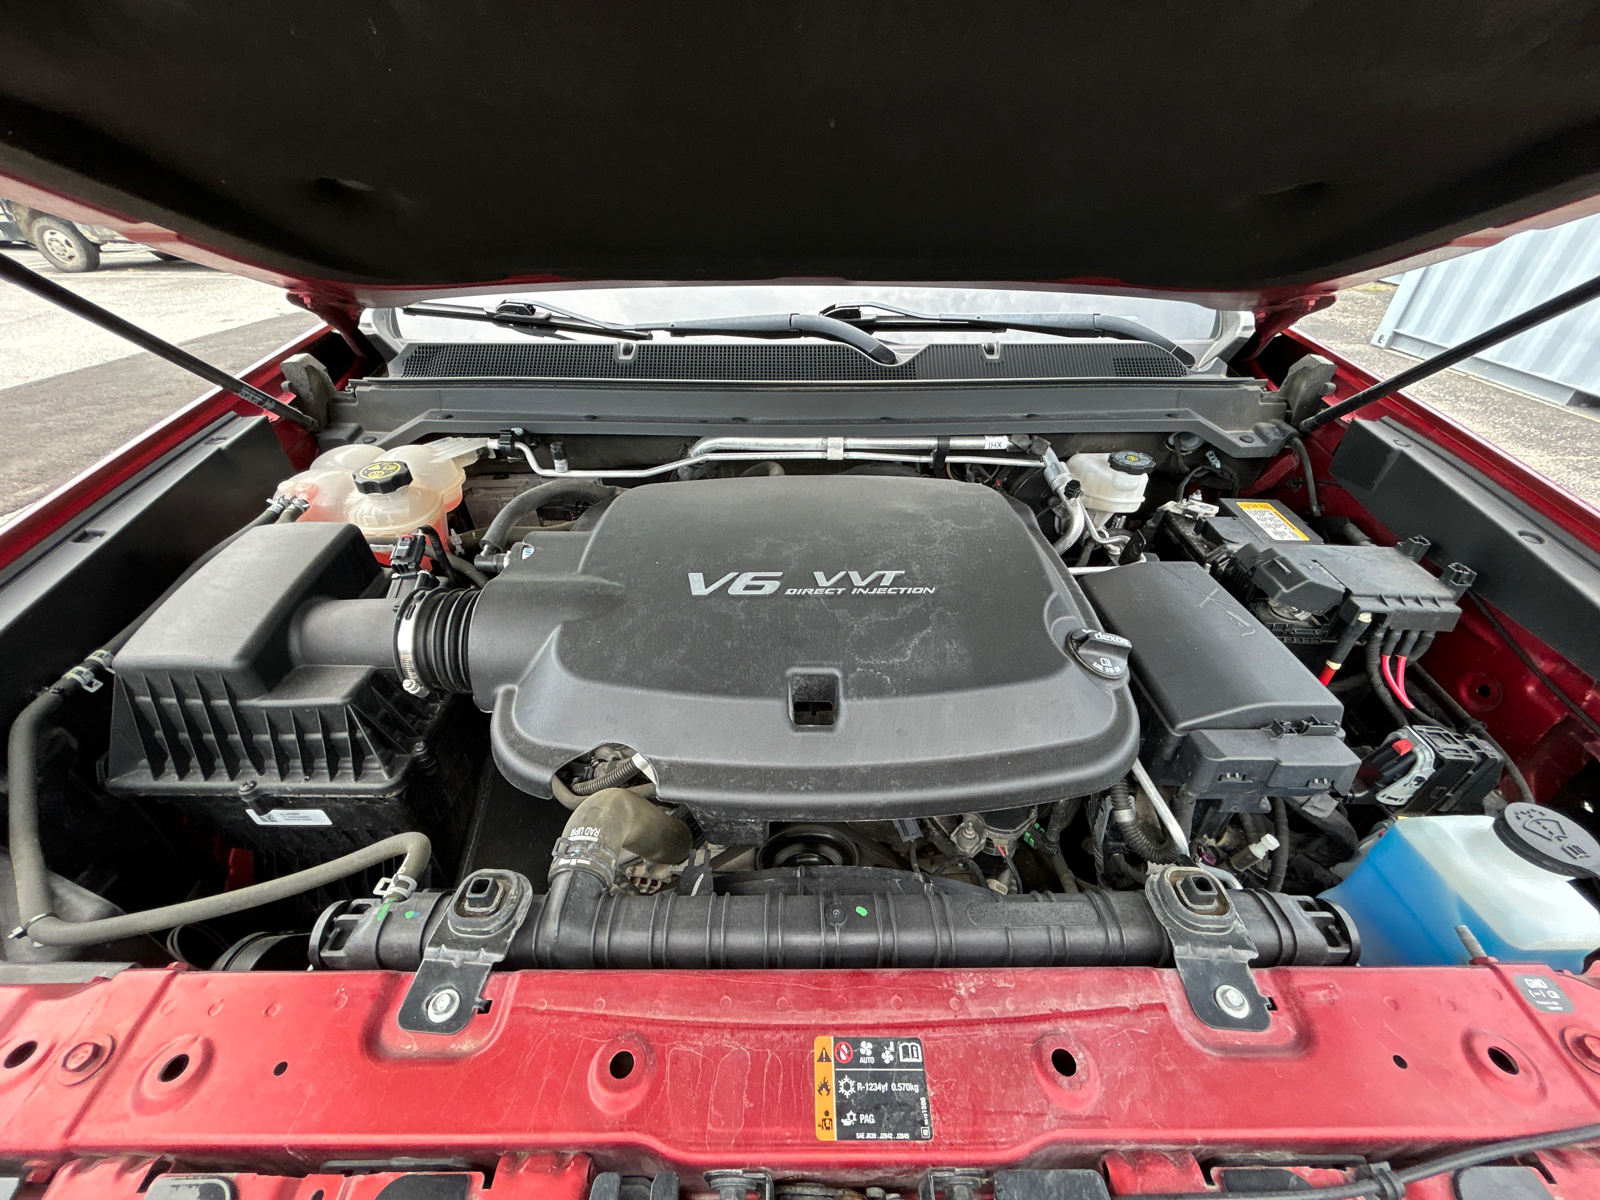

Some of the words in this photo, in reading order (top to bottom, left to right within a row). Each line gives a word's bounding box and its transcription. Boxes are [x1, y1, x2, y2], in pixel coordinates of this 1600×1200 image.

[687, 571, 784, 596] V6
[813, 570, 906, 587] VVT
[784, 587, 847, 596] DIRECT
[850, 586, 936, 595] INJECTION
[570, 826, 584, 836] UPR
[584, 826, 600, 836] RAD
[1524, 978, 1548, 989] GND
[857, 1082, 888, 1093] R-1234yf
[891, 1083, 919, 1093] 0.570kg
[860, 1114, 875, 1124] PAG
